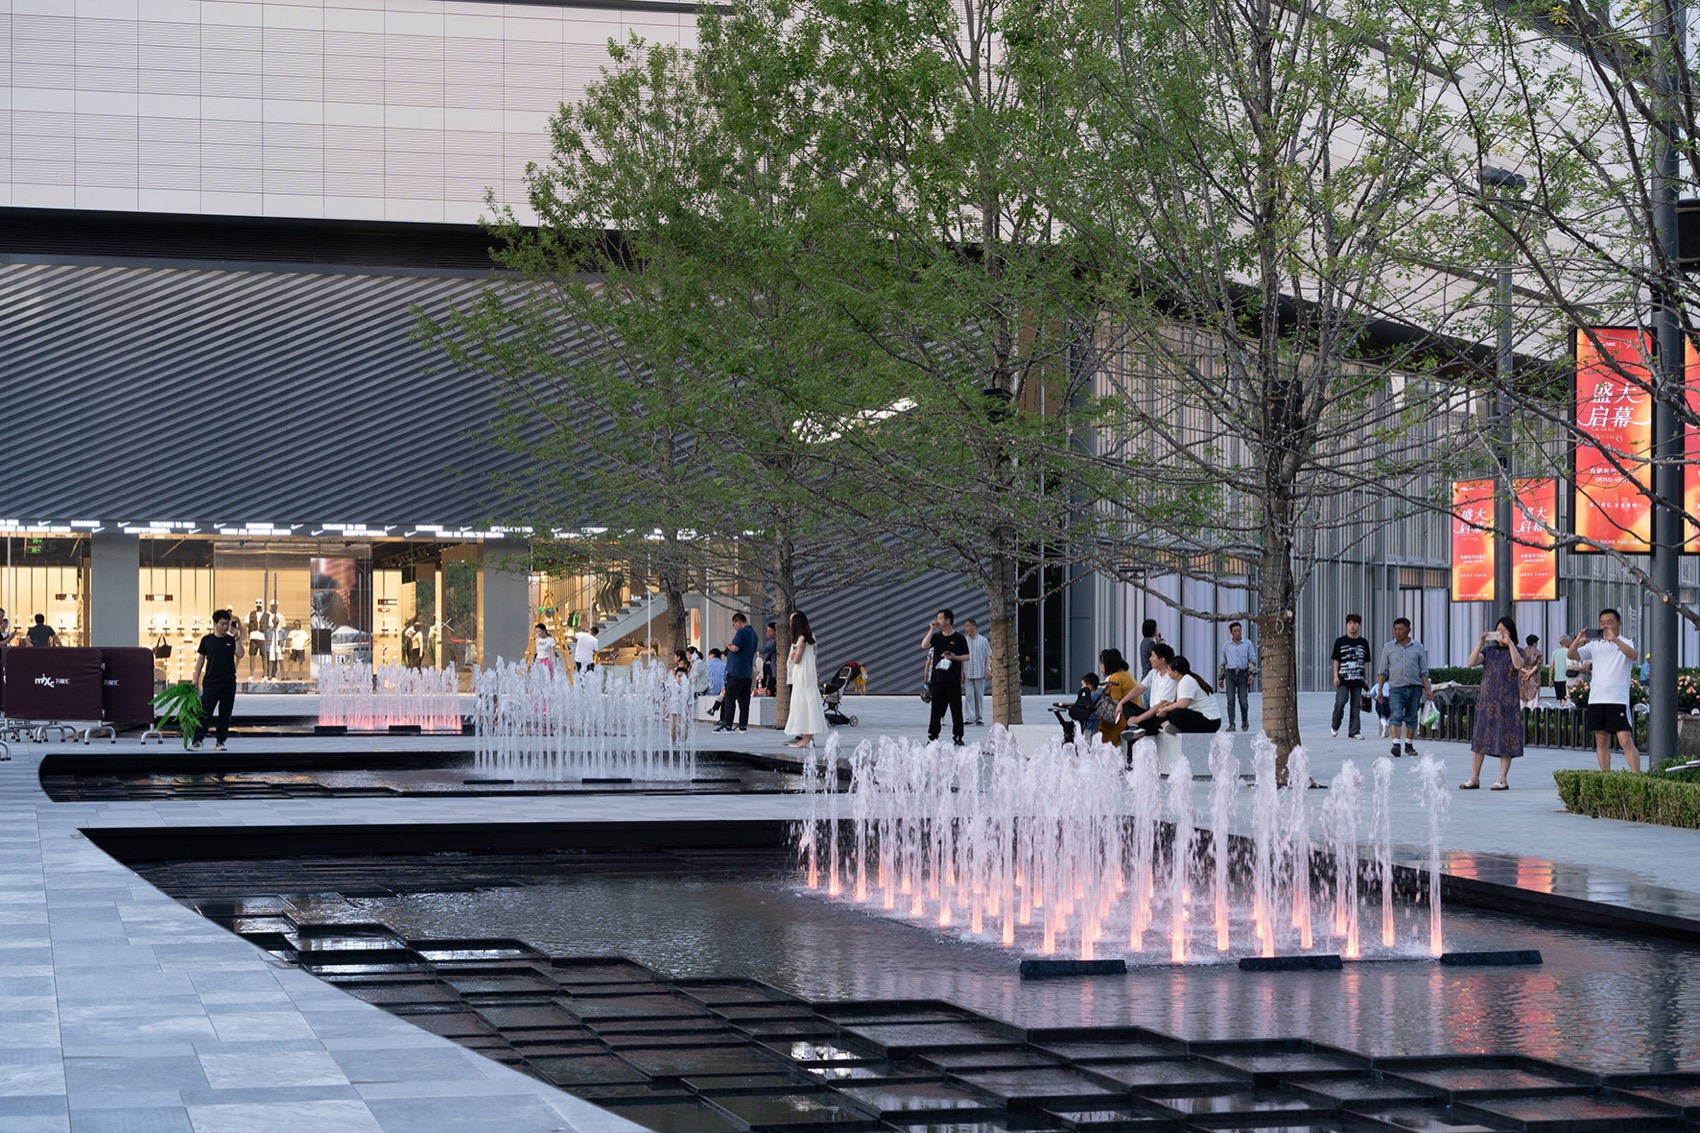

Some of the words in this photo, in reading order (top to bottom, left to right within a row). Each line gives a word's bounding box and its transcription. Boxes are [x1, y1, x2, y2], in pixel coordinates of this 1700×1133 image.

[1591, 382, 1645, 404] 盛大
[1578, 406, 1646, 428] 启幕
[1462, 508, 1489, 520] 盛大
